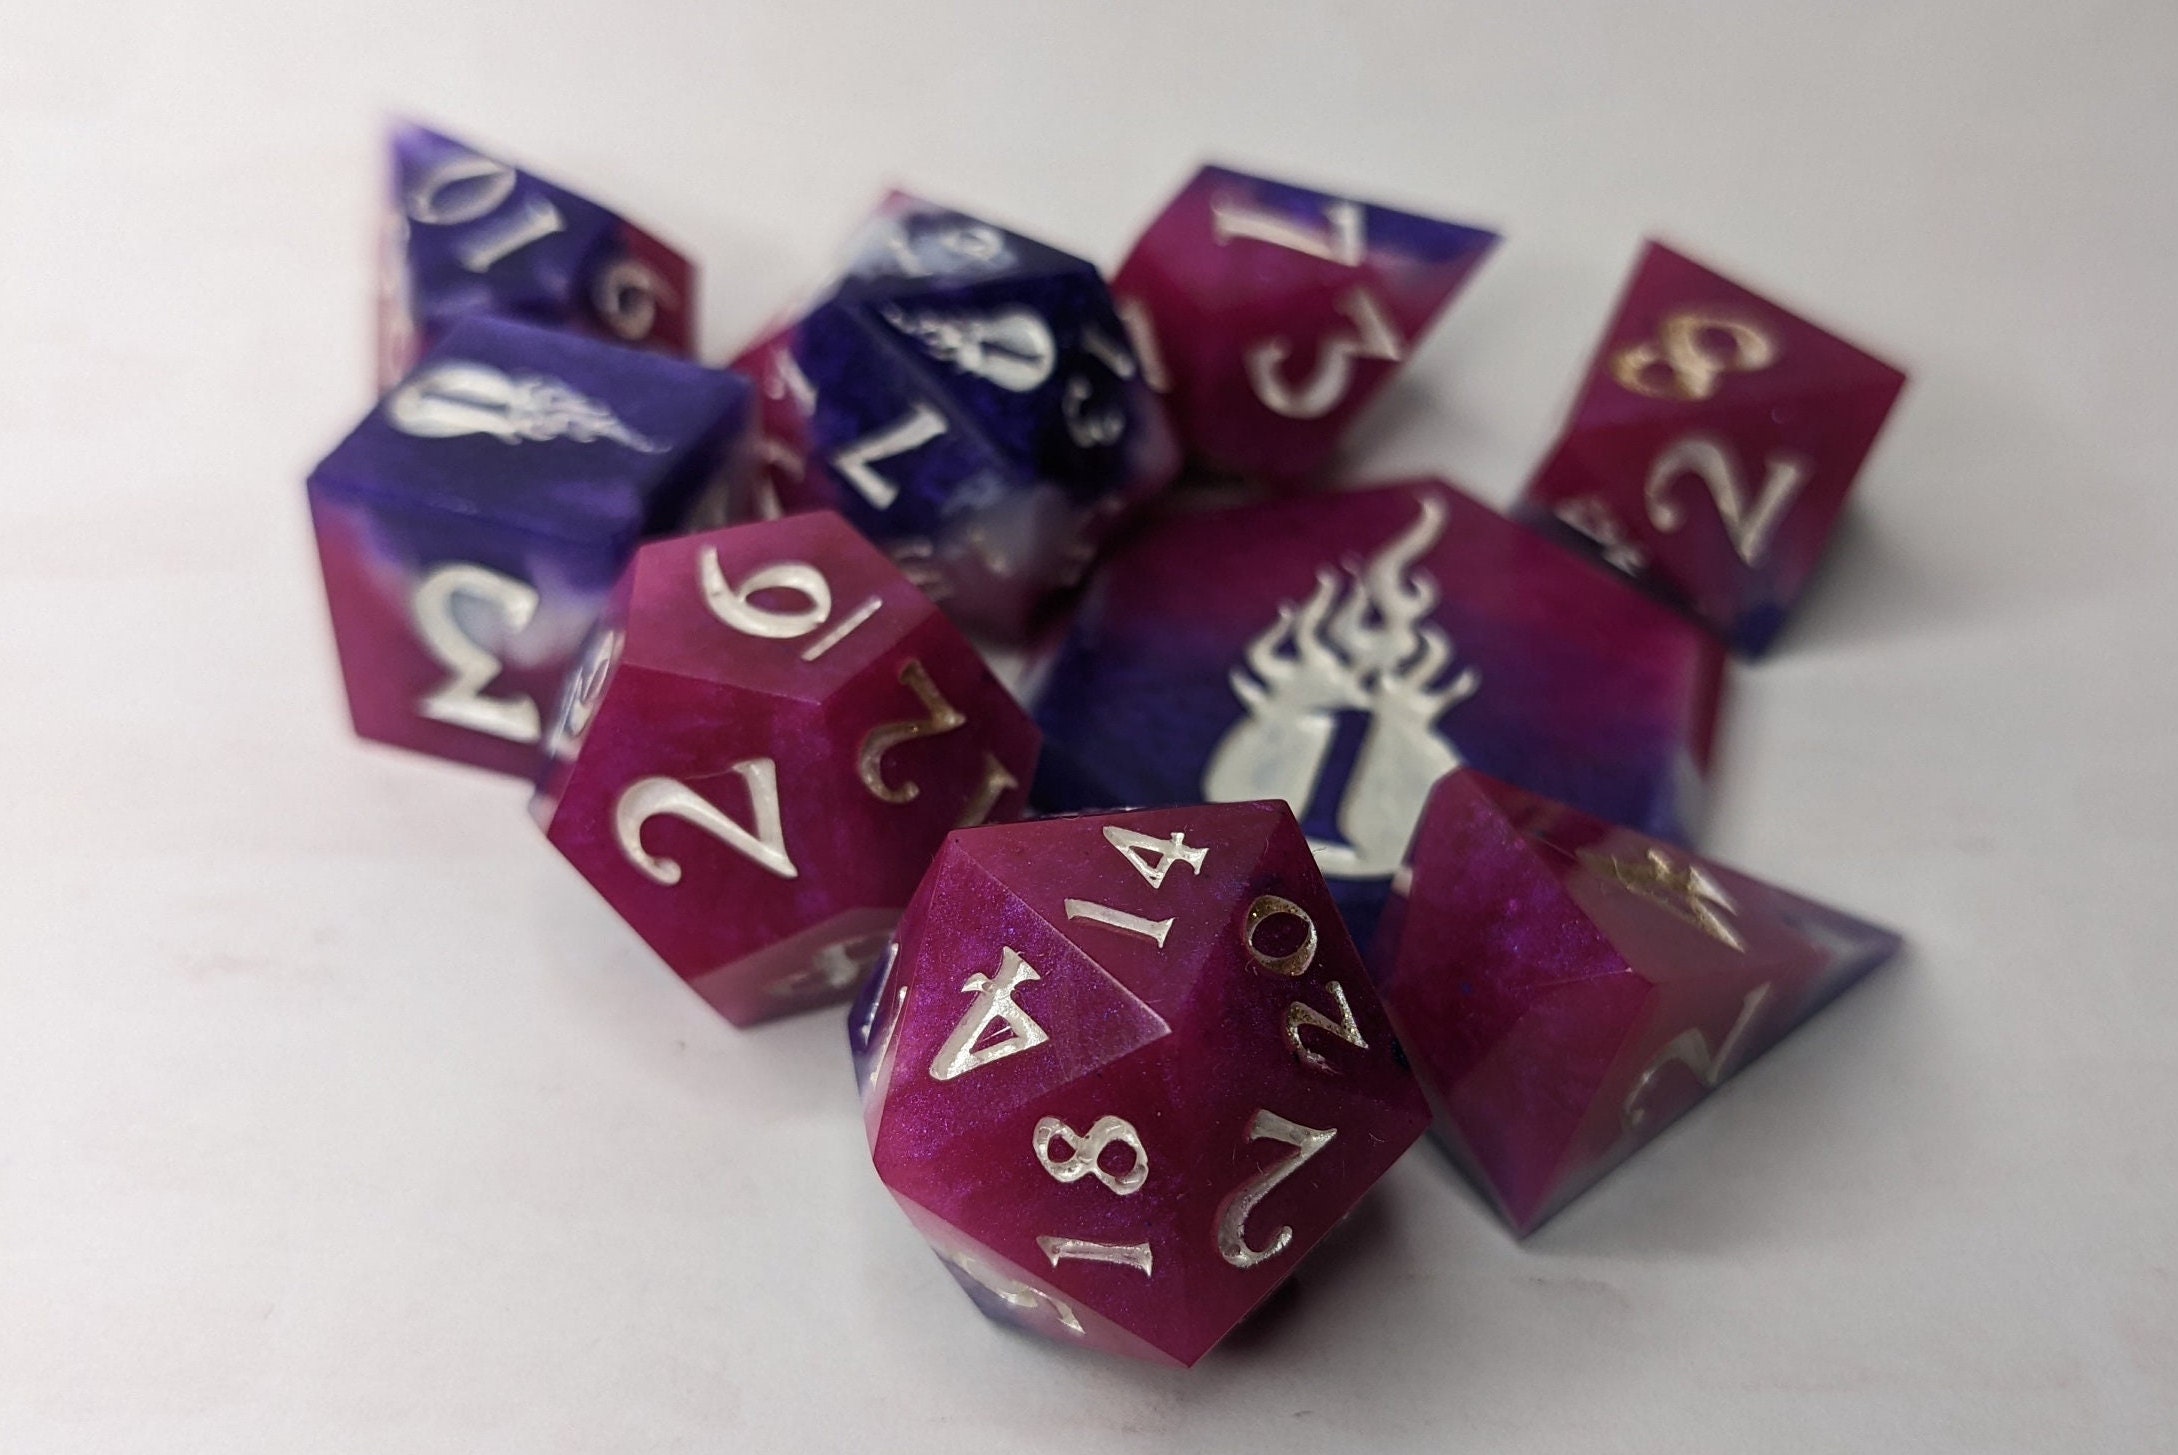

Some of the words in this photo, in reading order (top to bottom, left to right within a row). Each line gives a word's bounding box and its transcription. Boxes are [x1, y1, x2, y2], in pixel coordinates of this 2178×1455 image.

[1611, 312, 1778, 400] 8
[835, 404, 947, 508] 7
[1645, 439, 1807, 568] 2
[413, 562, 541, 743] 3
[701, 546, 832, 639] 6
[616, 757, 799, 886] 2
[1064, 825, 1208, 949] 14
[929, 945, 1050, 1081] 4
[1243, 894, 1369, 1075] 20
[1624, 982, 1771, 1130] 2
[1032, 1114, 1153, 1278] 18
[1218, 1108, 1338, 1269] 2
